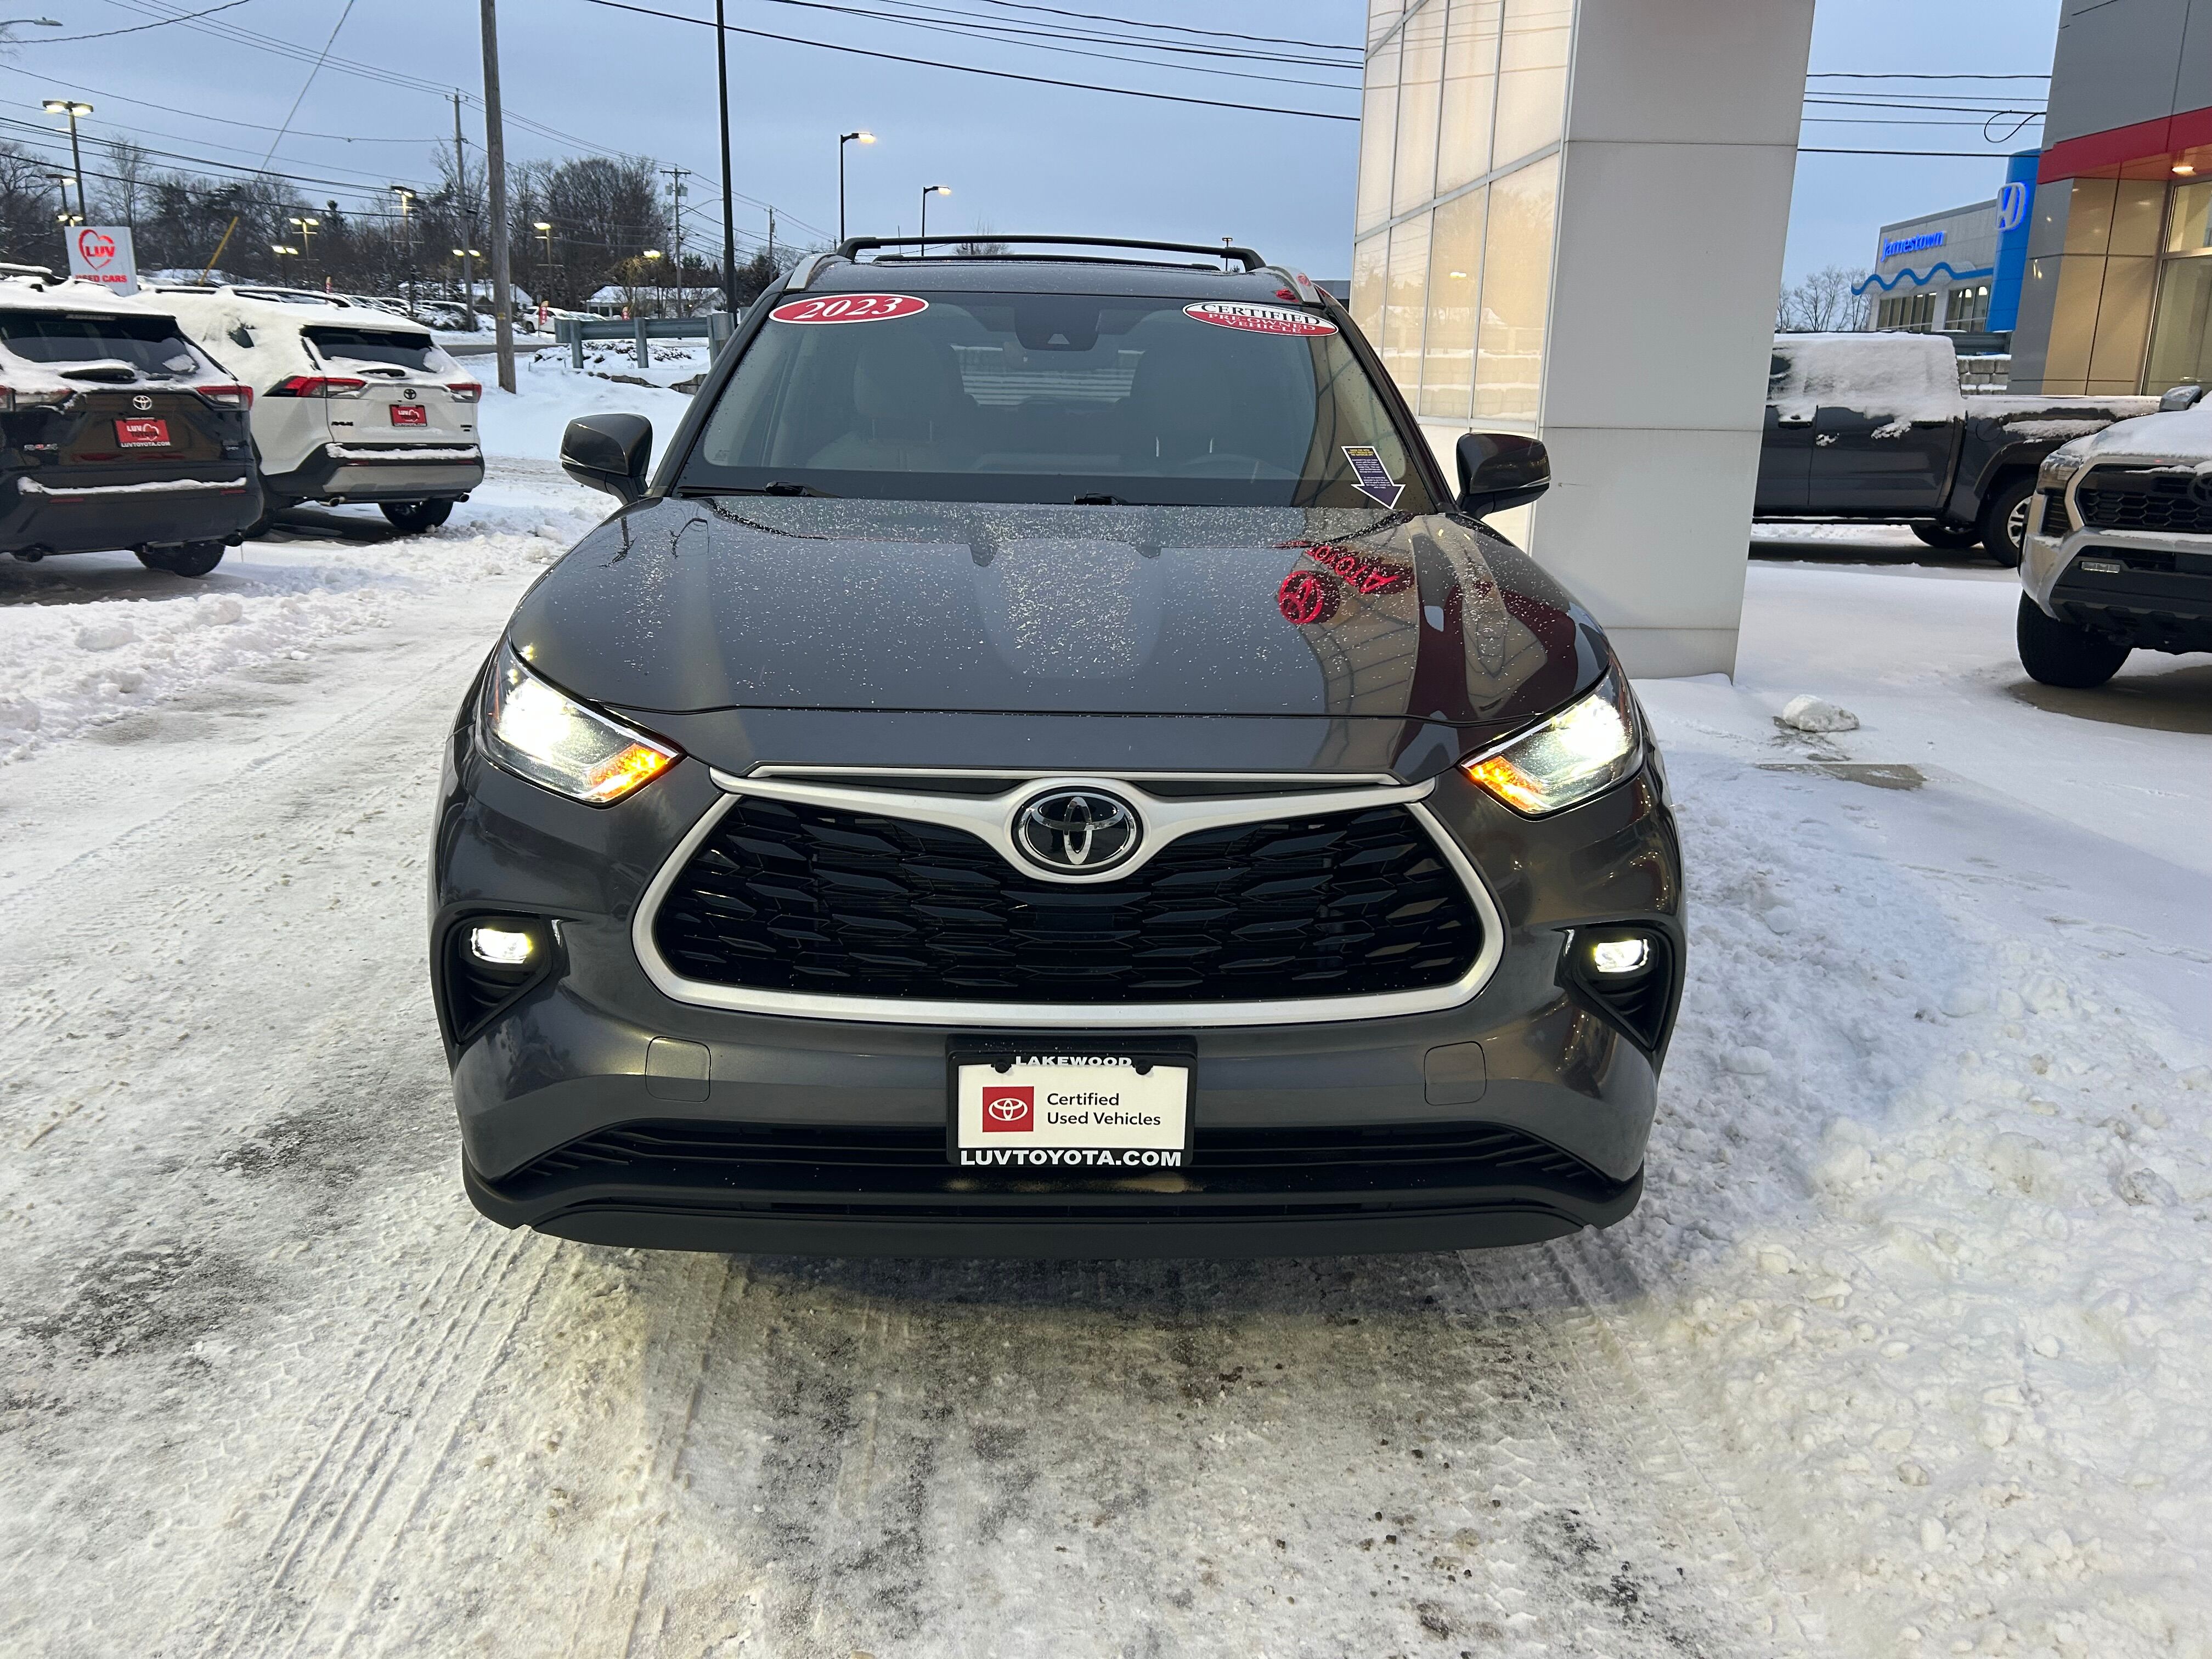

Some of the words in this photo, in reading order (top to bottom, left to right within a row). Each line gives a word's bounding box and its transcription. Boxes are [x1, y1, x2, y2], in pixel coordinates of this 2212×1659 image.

[85, 246, 115, 257] LUV
[1881, 230, 1945, 263] Jamestown
[102, 275, 127, 283] CARS
[793, 297, 903, 319] 2023
[1201, 304, 1320, 325] CERTIFIED
[1208, 313, 1316, 330] PRE-OWNED
[1224, 320, 1302, 333] VEHICLE
[1015, 1056, 1132, 1066] LAKEWOOD
[1047, 1093, 1119, 1106] Certified
[1047, 1111, 1088, 1125] Used
[1093, 1112, 1161, 1126] Vehicles
[960, 1150, 1182, 1166] LUVTOYOTA.COM
